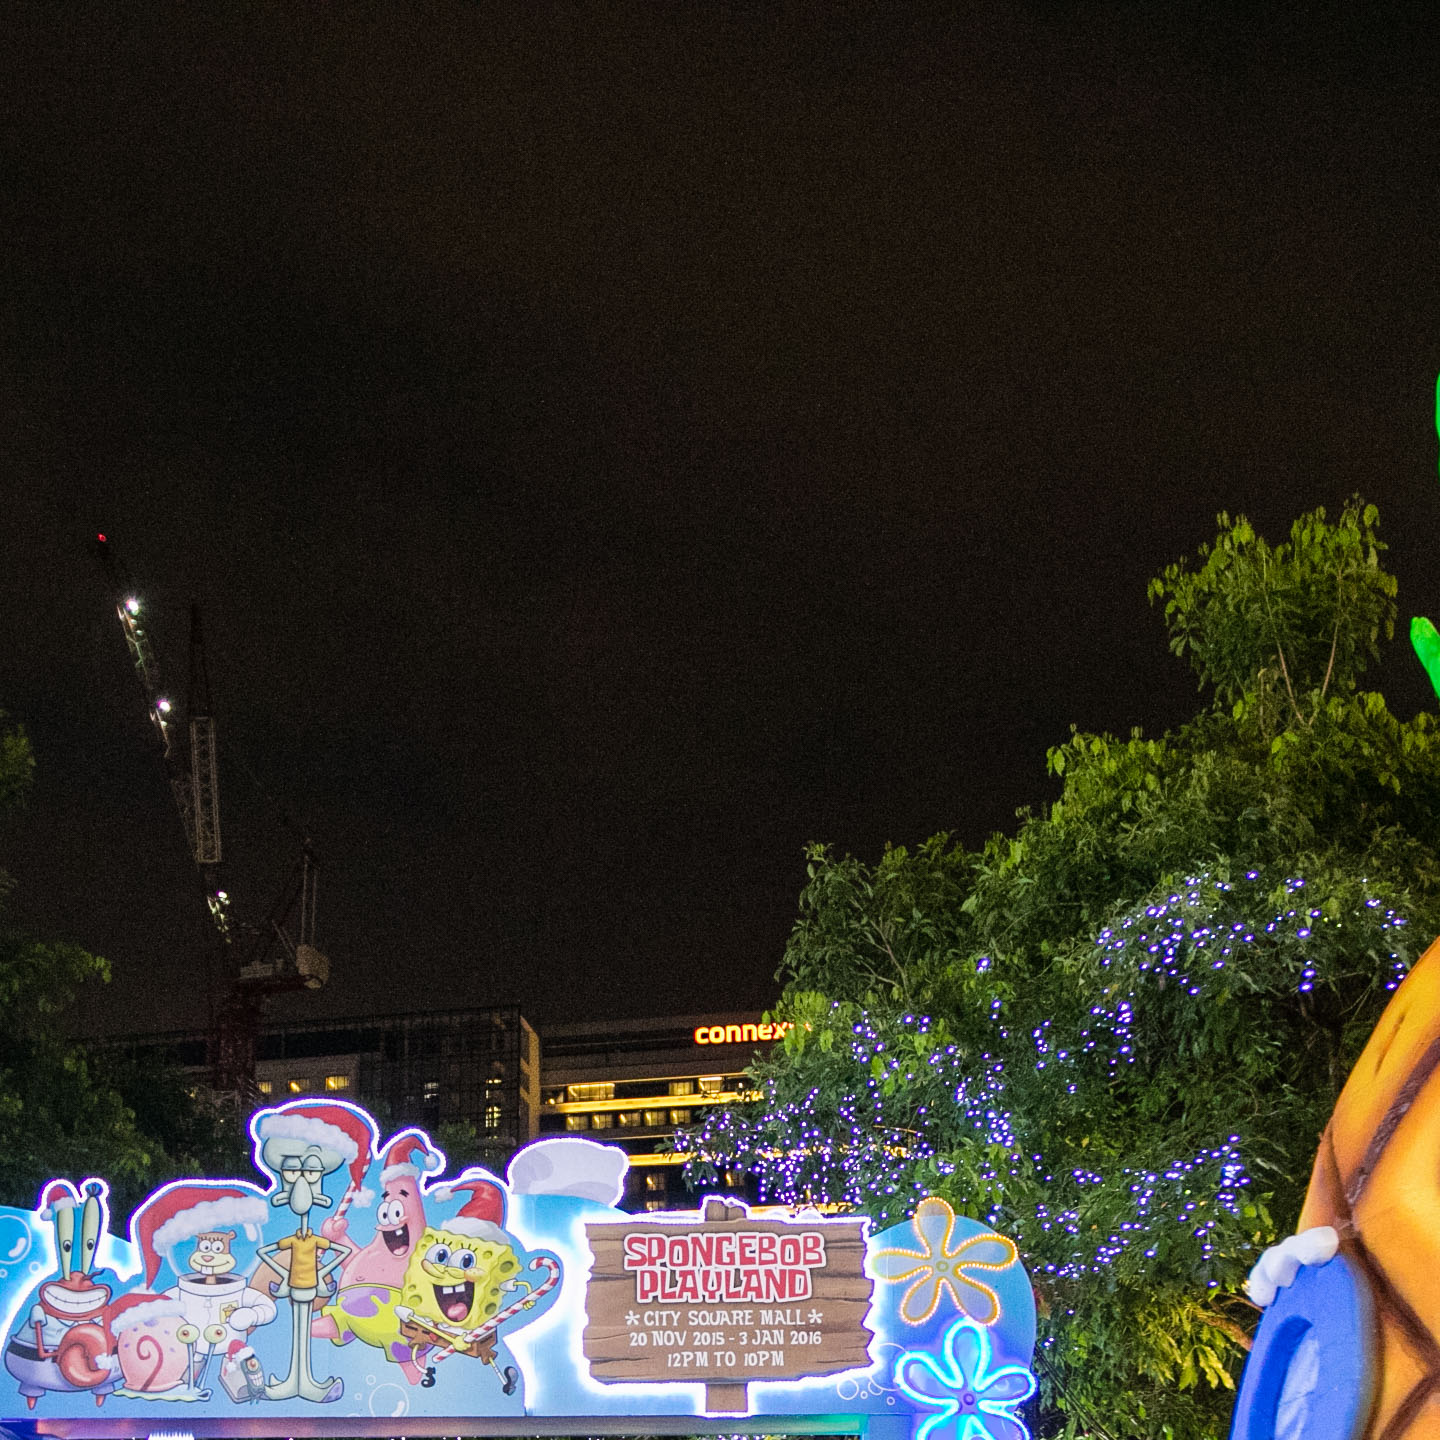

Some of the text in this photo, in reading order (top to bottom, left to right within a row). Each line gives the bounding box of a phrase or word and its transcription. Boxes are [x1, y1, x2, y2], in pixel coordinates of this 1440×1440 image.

[694, 1021, 811, 1045] connex
[624, 1233, 826, 1269] SPONGEBOB
[638, 1268, 810, 1302] PLAYLAND
[643, 1309, 805, 1327] CITY SQUARE MALL
[629, 1331, 648, 1347] 20
[652, 1330, 688, 1347] NOV
[692, 1331, 725, 1347] 2015
[739, 1331, 748, 1346] 3
[751, 1330, 785, 1346] JAN
[790, 1330, 822, 1346] 2016
[667, 1350, 785, 1368] 12PM TO 10PM
